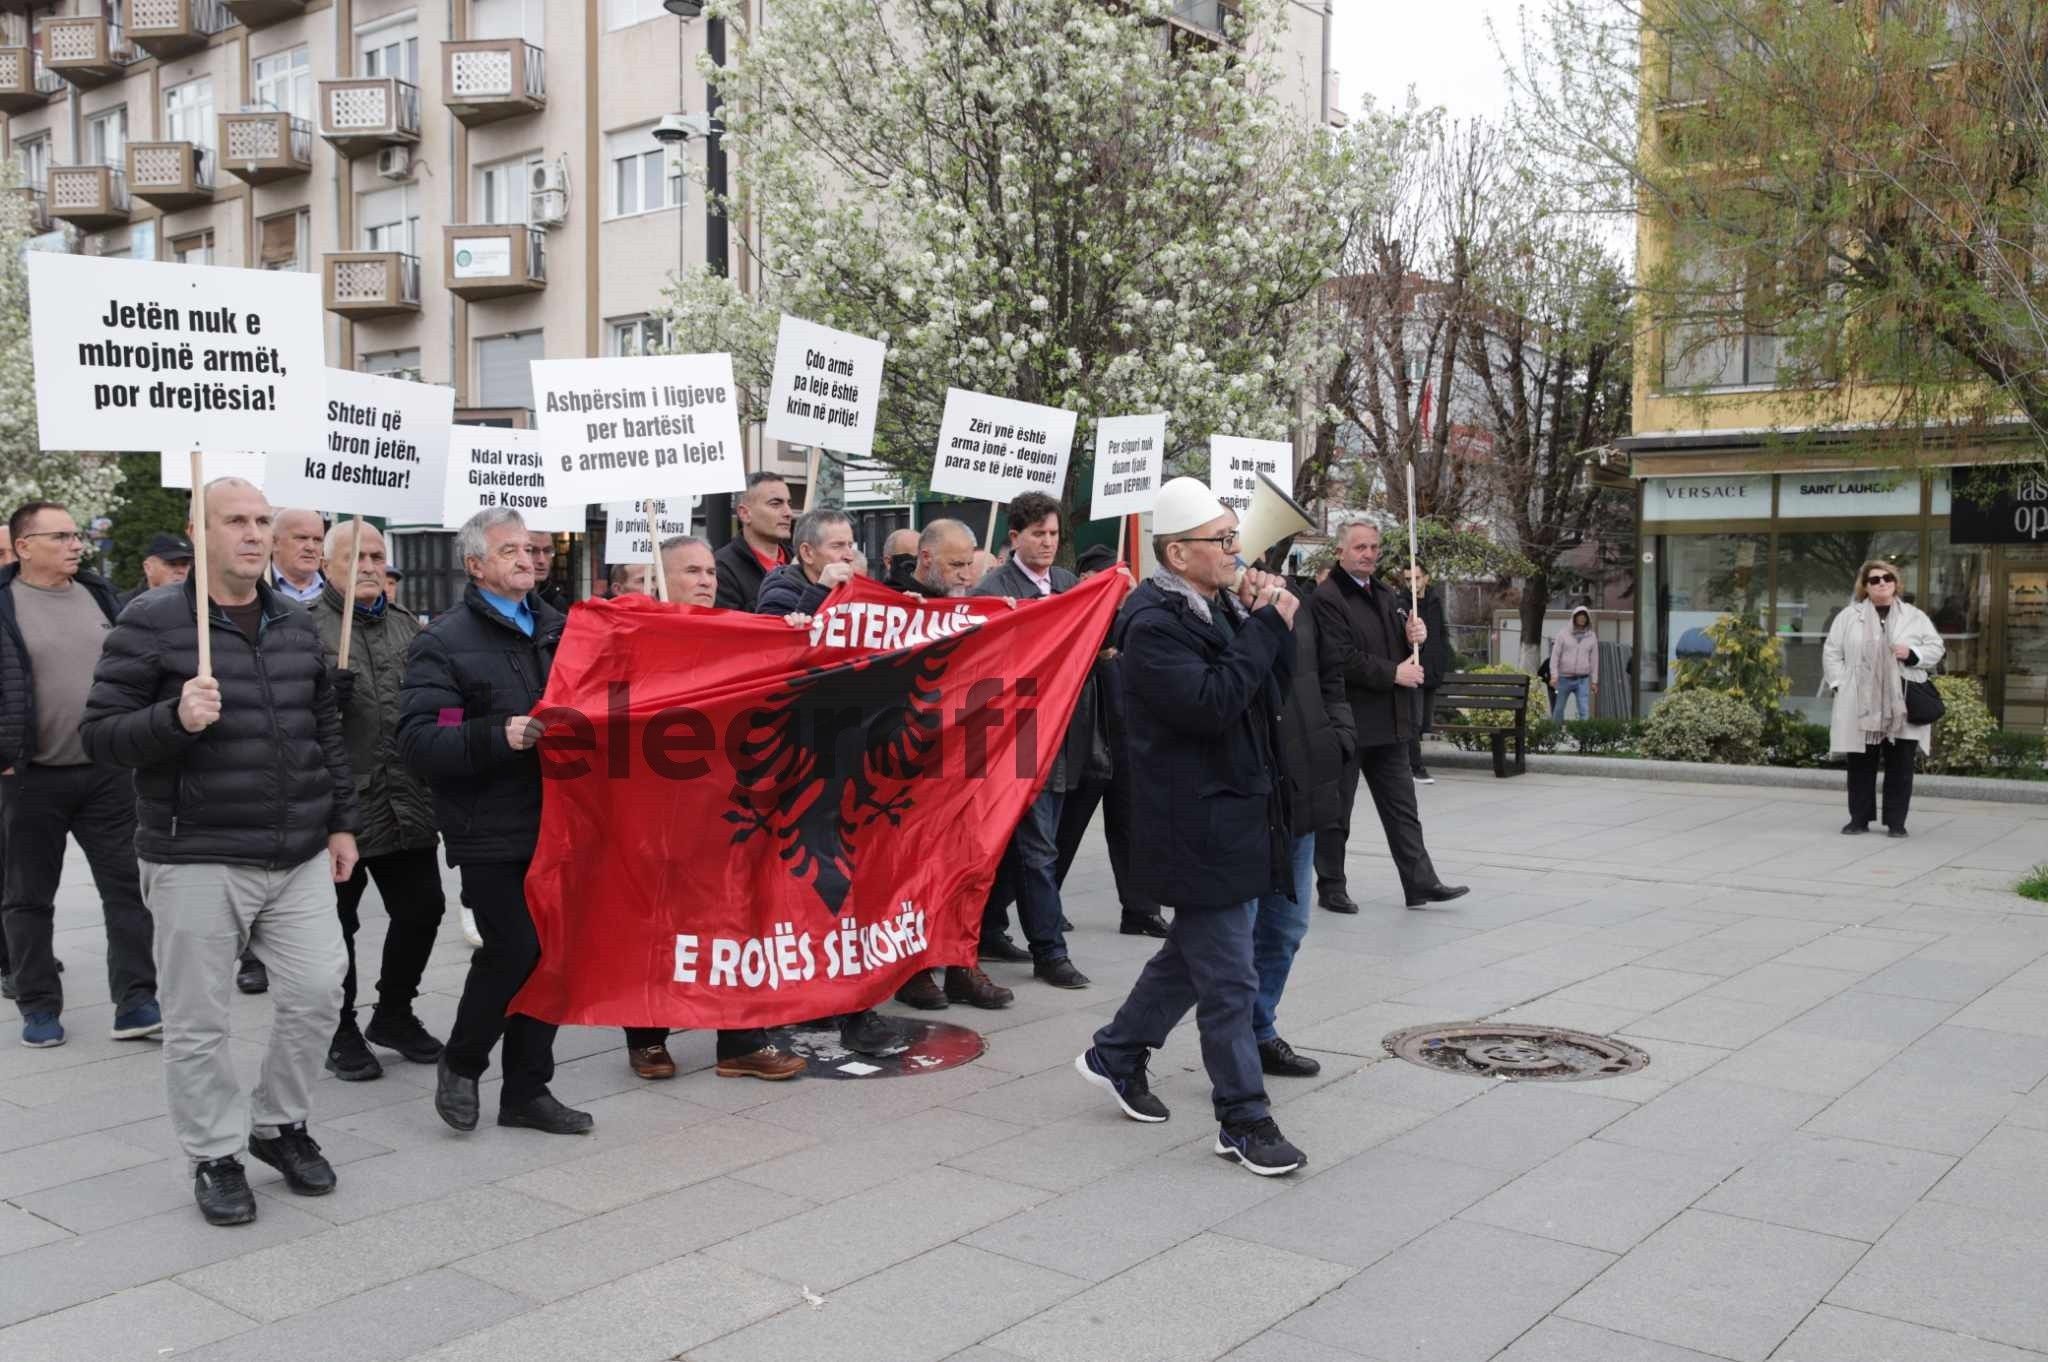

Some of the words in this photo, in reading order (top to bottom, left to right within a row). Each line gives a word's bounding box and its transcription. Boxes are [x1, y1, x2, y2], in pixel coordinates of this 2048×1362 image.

[102, 299, 180, 331] Jetën
[188, 307, 238, 334] nuk
[246, 312, 261, 335] e
[78, 339, 194, 372] mbrojnë
[203, 346, 287, 377] armët,
[827, 358, 855, 377] armë
[94, 383, 140, 410] por
[149, 381, 276, 412] drejtësia!
[546, 387, 647, 414] Ashpërsim
[651, 386, 659, 407] i
[664, 385, 727, 408] ligjeve
[793, 374, 808, 392] pa
[809, 375, 829, 397] leje
[831, 380, 859, 403] është
[327, 400, 377, 427] Shteti
[381, 409, 403, 432] që
[786, 395, 812, 418] krim
[812, 402, 827, 421] në
[827, 407, 860, 428] pritje!
[586, 421, 618, 443] per
[622, 413, 695, 439] bartësit
[969, 418, 993, 434] Zëri
[994, 422, 1014, 439] ynë
[1016, 427, 1047, 445] është
[373, 436, 420, 464] jetën,
[471, 448, 503, 465] Ndal
[560, 454, 573, 473] e
[579, 449, 650, 471] armeve
[655, 446, 678, 468] pa
[683, 440, 726, 465] leje!
[951, 436, 980, 452] arma
[981, 440, 1007, 456] jonë
[1017, 446, 1058, 466] degjoni
[1230, 457, 1240, 471] Jo
[1241, 458, 1255, 472] më
[304, 457, 327, 480] ka
[331, 461, 411, 489] deshtuar!
[945, 455, 971, 469] para
[972, 460, 986, 473] se
[988, 460, 1000, 475] të
[1001, 462, 1024, 479] jetë
[1026, 468, 1057, 485] vonë!
[480, 491, 497, 507] në
[500, 491, 549, 509] Kosove
[1666, 485, 1748, 499] VERSACE
[1800, 483, 1836, 496] SAINT
[673, 934, 698, 983] E
[709, 921, 816, 991] ROJËS
[823, 916, 862, 979] SË
